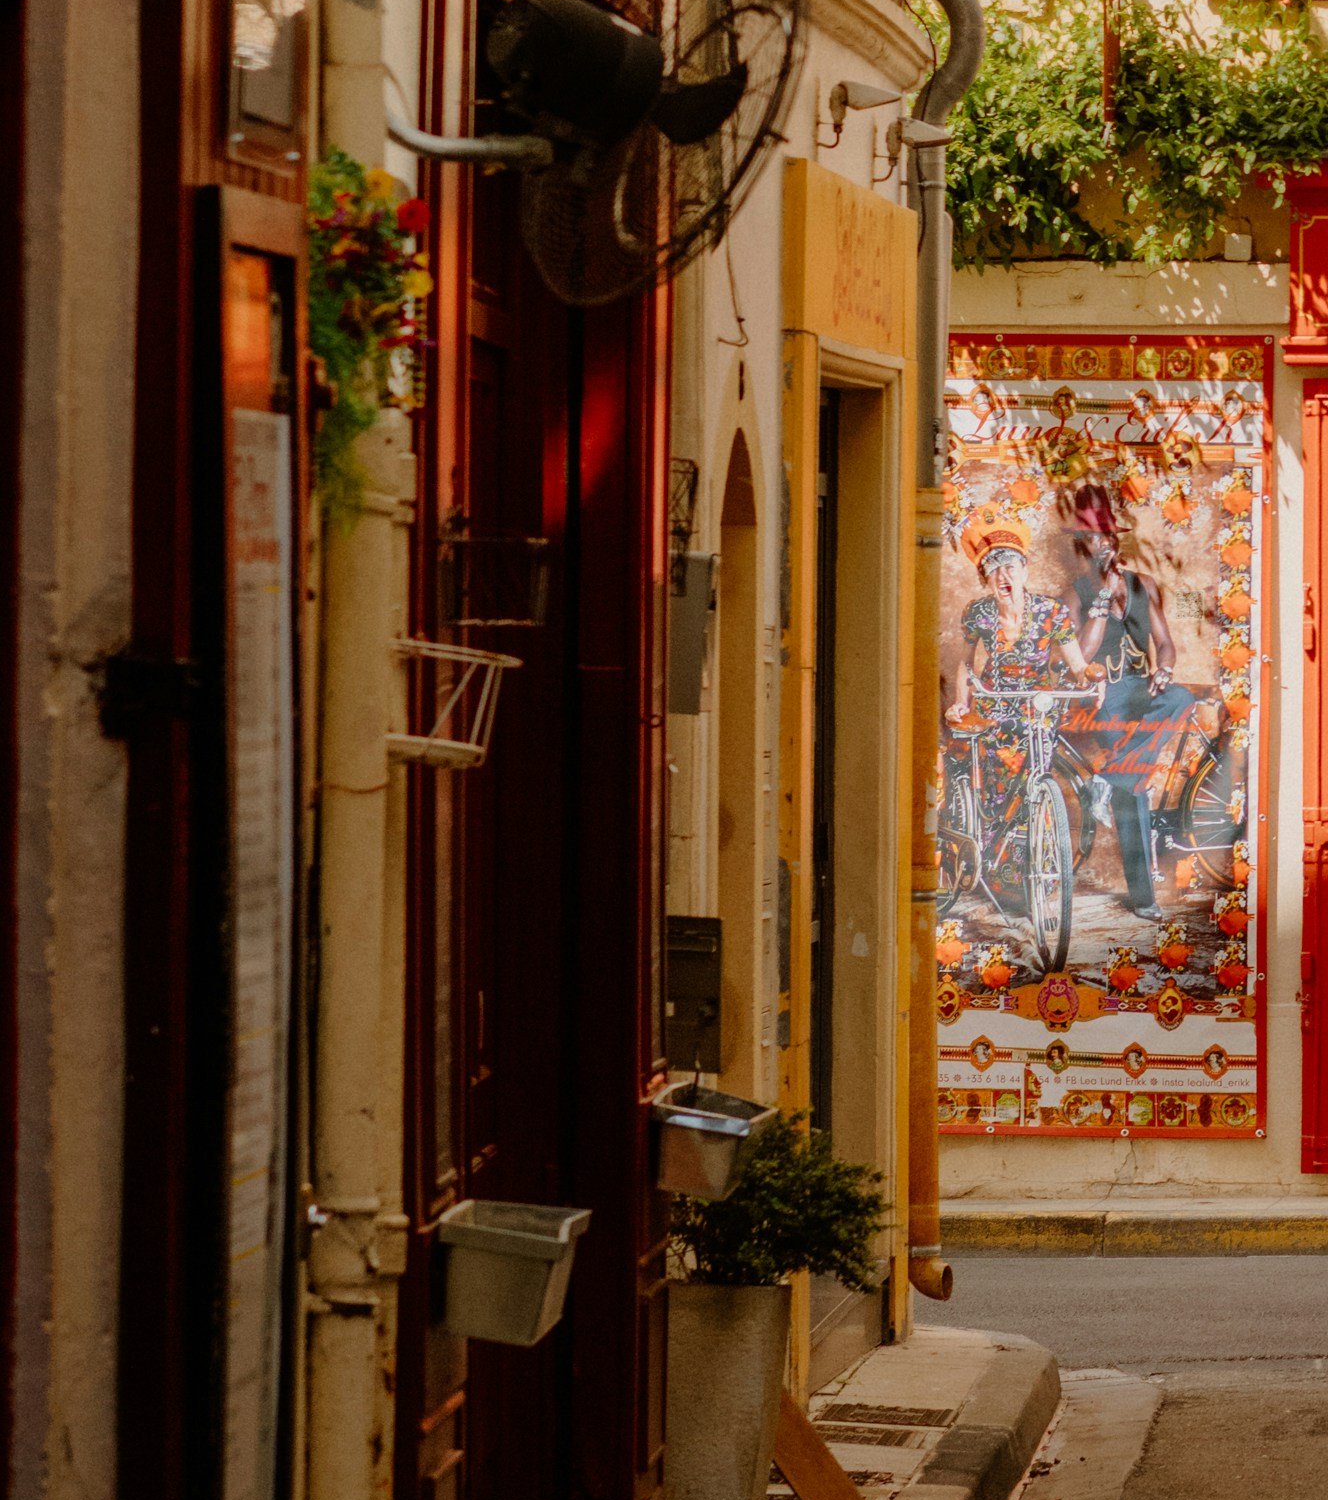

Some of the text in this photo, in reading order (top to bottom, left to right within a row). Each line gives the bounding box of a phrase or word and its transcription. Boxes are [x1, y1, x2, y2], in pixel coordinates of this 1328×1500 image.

[966, 1074, 982, 1083] +33
[985, 1074, 992, 1083] 6
[996, 1074, 1006, 1083] 18
[1009, 1074, 1021, 1083] 44
[1080, 1075, 1097, 1085] Lea
[1100, 1076, 1122, 1086] Lund
[1125, 1076, 1147, 1086] Erikk
[1161, 1077, 1184, 1087] insta
[1187, 1077, 1250, 1088] lealund_erikk
